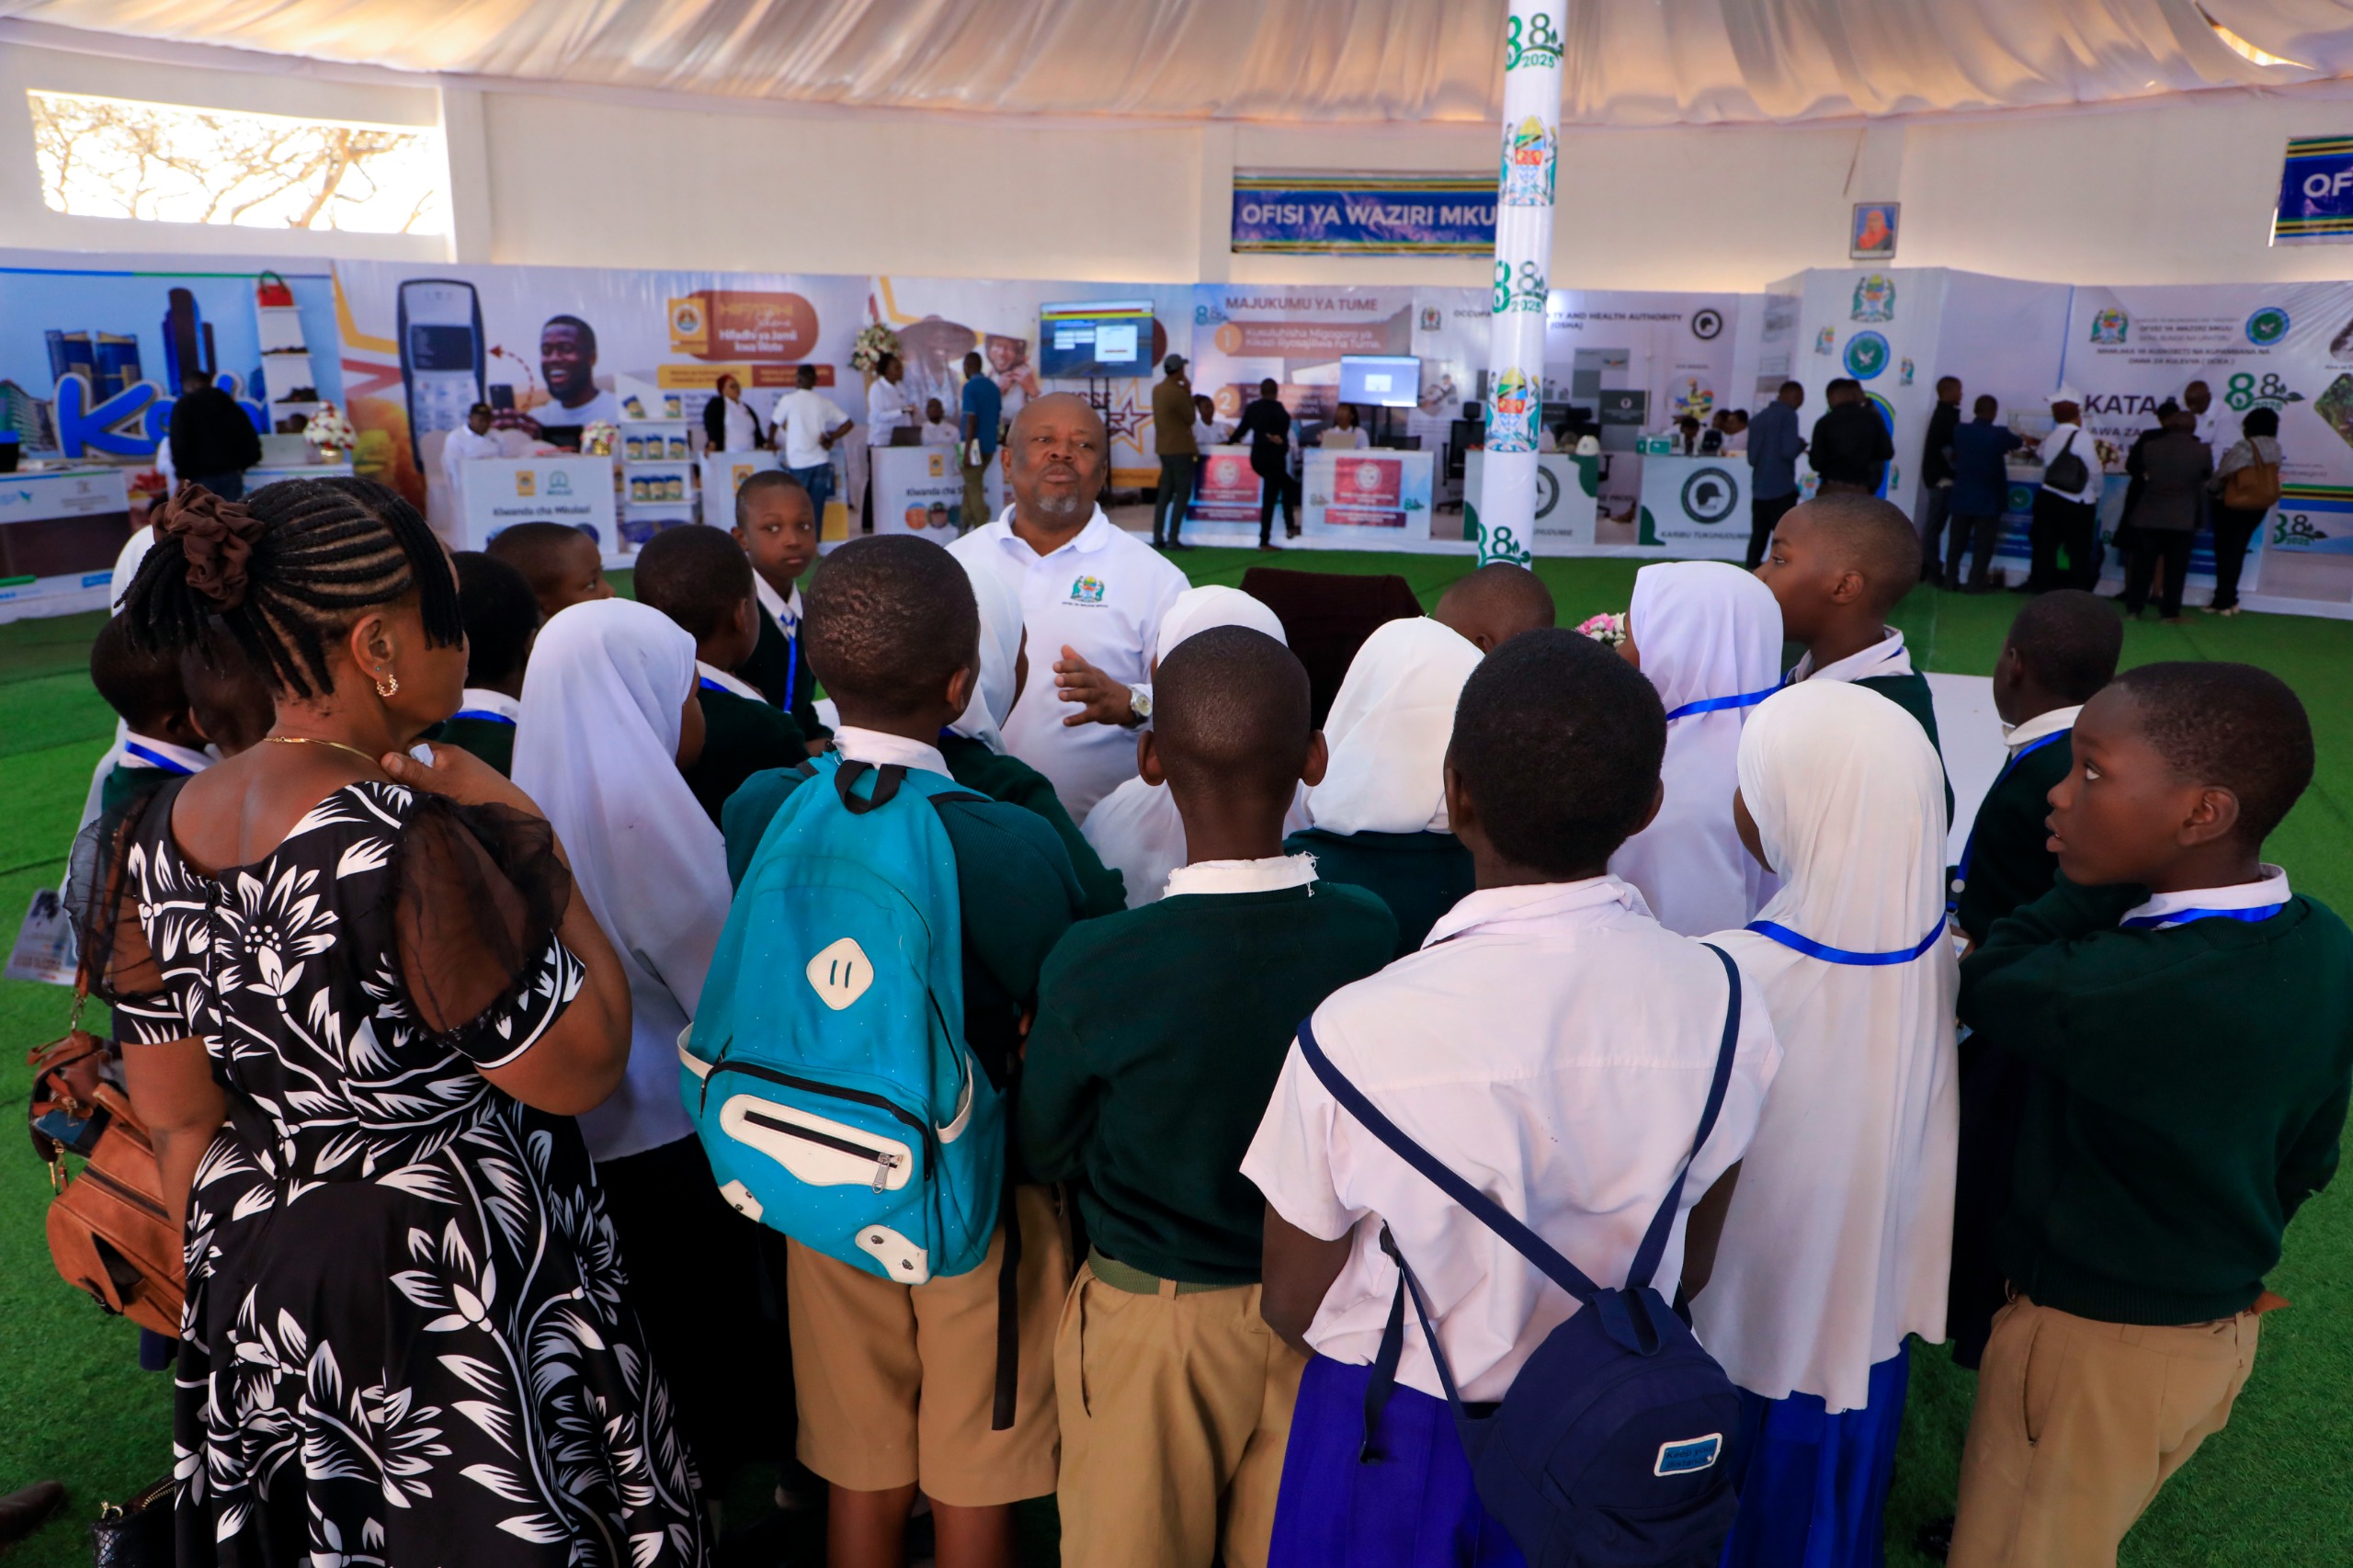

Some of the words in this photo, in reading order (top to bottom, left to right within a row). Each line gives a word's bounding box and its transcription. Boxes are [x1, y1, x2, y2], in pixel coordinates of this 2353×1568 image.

[1522, 52, 1555, 69] 2025
[1242, 203, 1304, 225] OFISI
[1309, 204, 1342, 225] YA
[1345, 204, 1434, 225] WAZIRI
[1225, 296, 1313, 311] MAJUKUMU
[1314, 297, 1336, 311] YA
[1338, 297, 1379, 312] TUME
[1511, 299, 1542, 313] 2025
[1588, 312, 1626, 321] HEALTH
[1629, 312, 1682, 322] AUTHORITY
[1223, 330, 1231, 348] 1
[2225, 372, 2256, 411] 8
[2260, 372, 2279, 396] 8
[1219, 393, 1232, 410] 2
